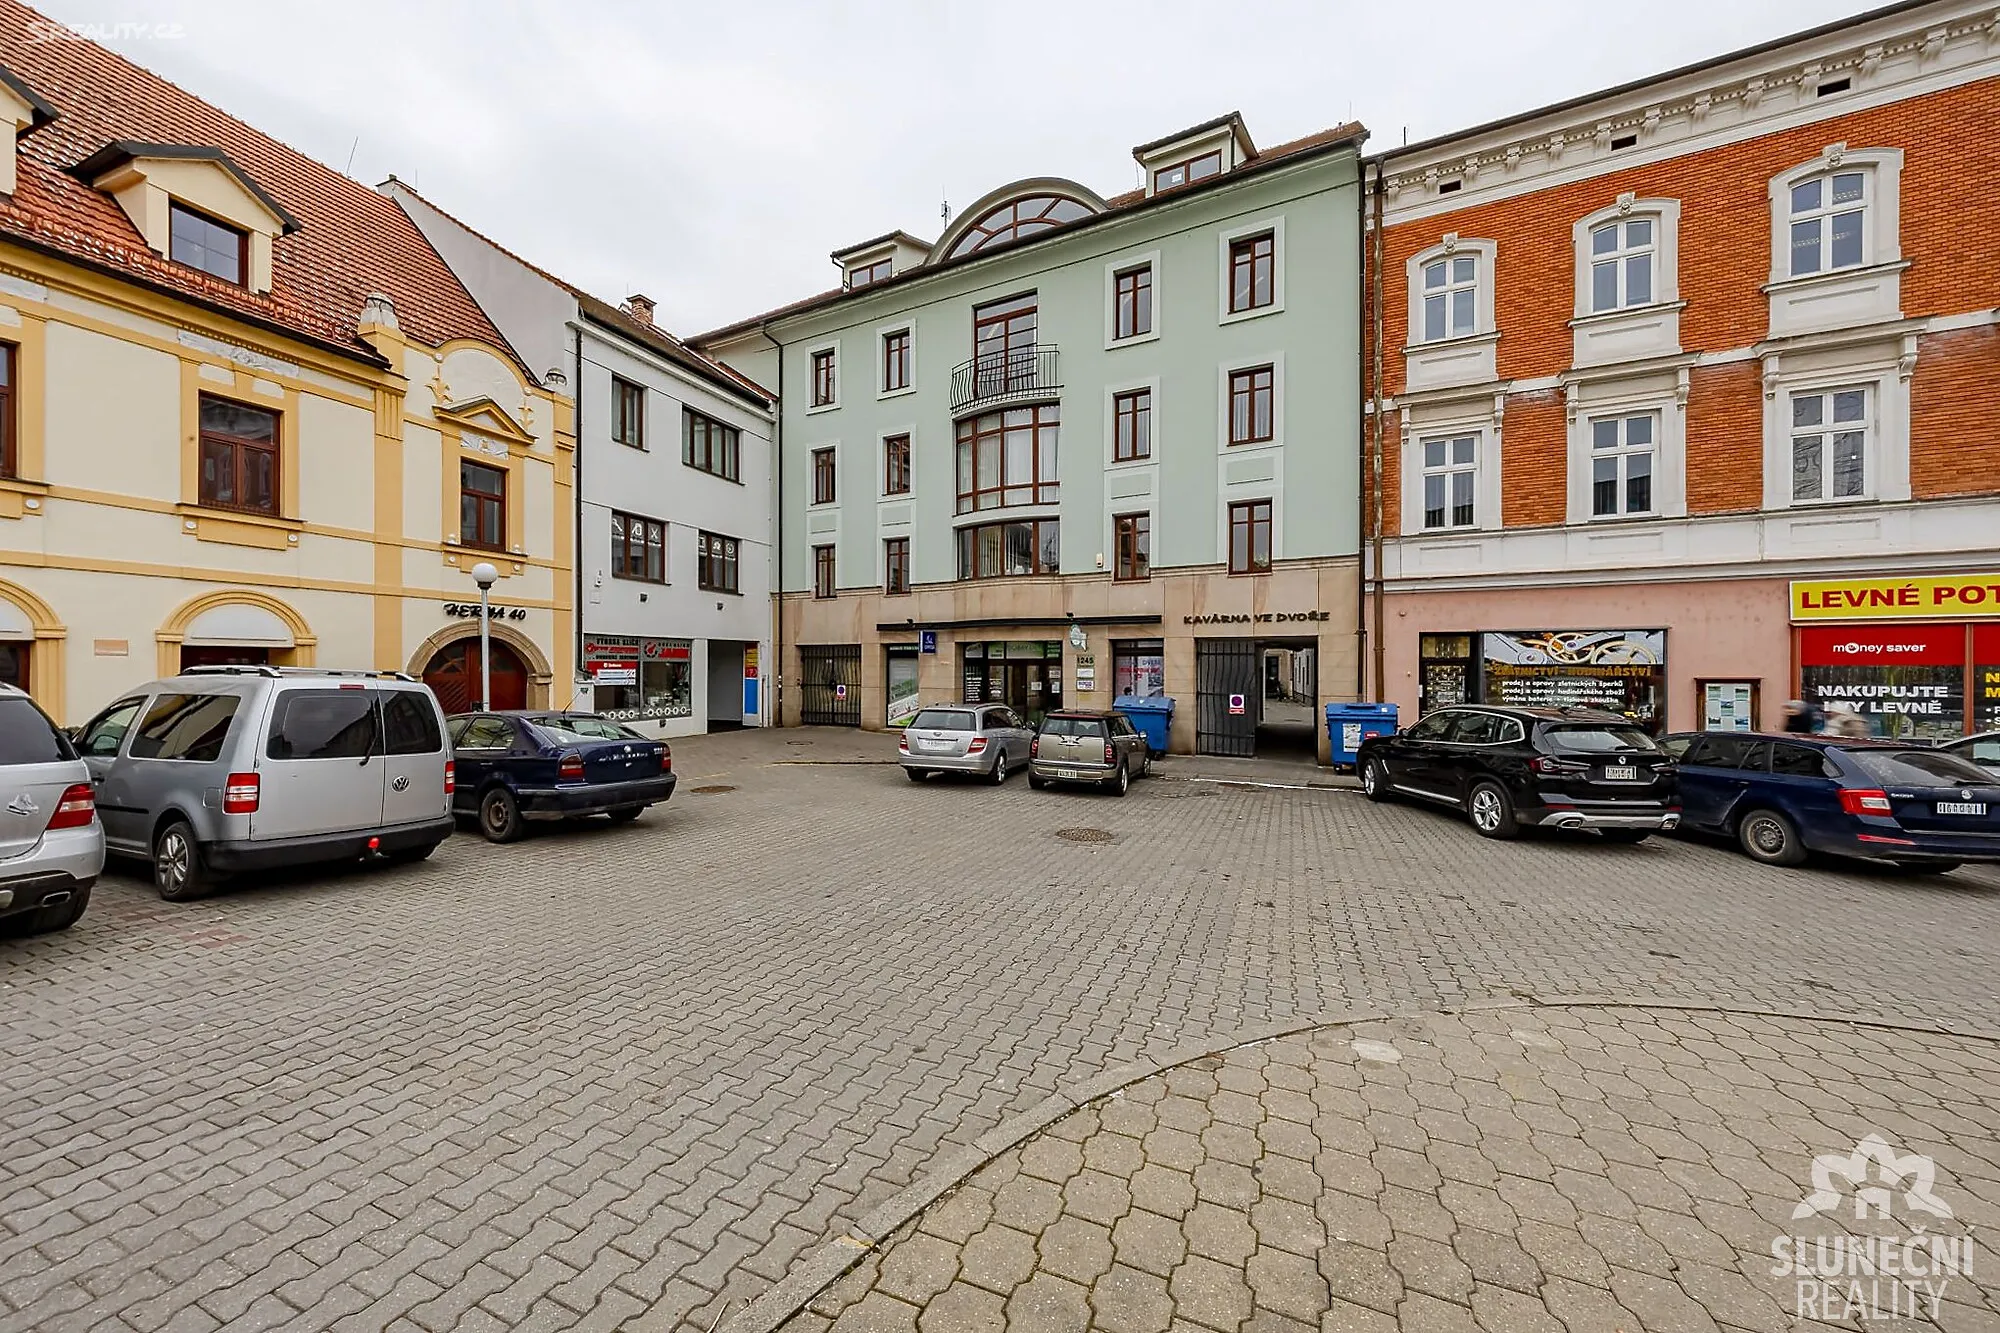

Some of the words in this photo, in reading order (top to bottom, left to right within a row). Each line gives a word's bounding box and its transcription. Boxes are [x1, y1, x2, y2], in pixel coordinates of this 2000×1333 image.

[1801, 583, 1920, 609] LEVNÉ
[508, 609, 526, 620] 40
[1183, 613, 1251, 625] KAVÁRNA
[1254, 613, 1273, 623] VE
[1276, 610, 1331, 623] DVOŘE
[1832, 642, 1884, 655] money
[1886, 643, 1927, 653] saver
[1077, 656, 1094, 665] 1245
[1818, 685, 1948, 698] NAKUPUJTE
[1870, 700, 1942, 714] LEVNĚ
